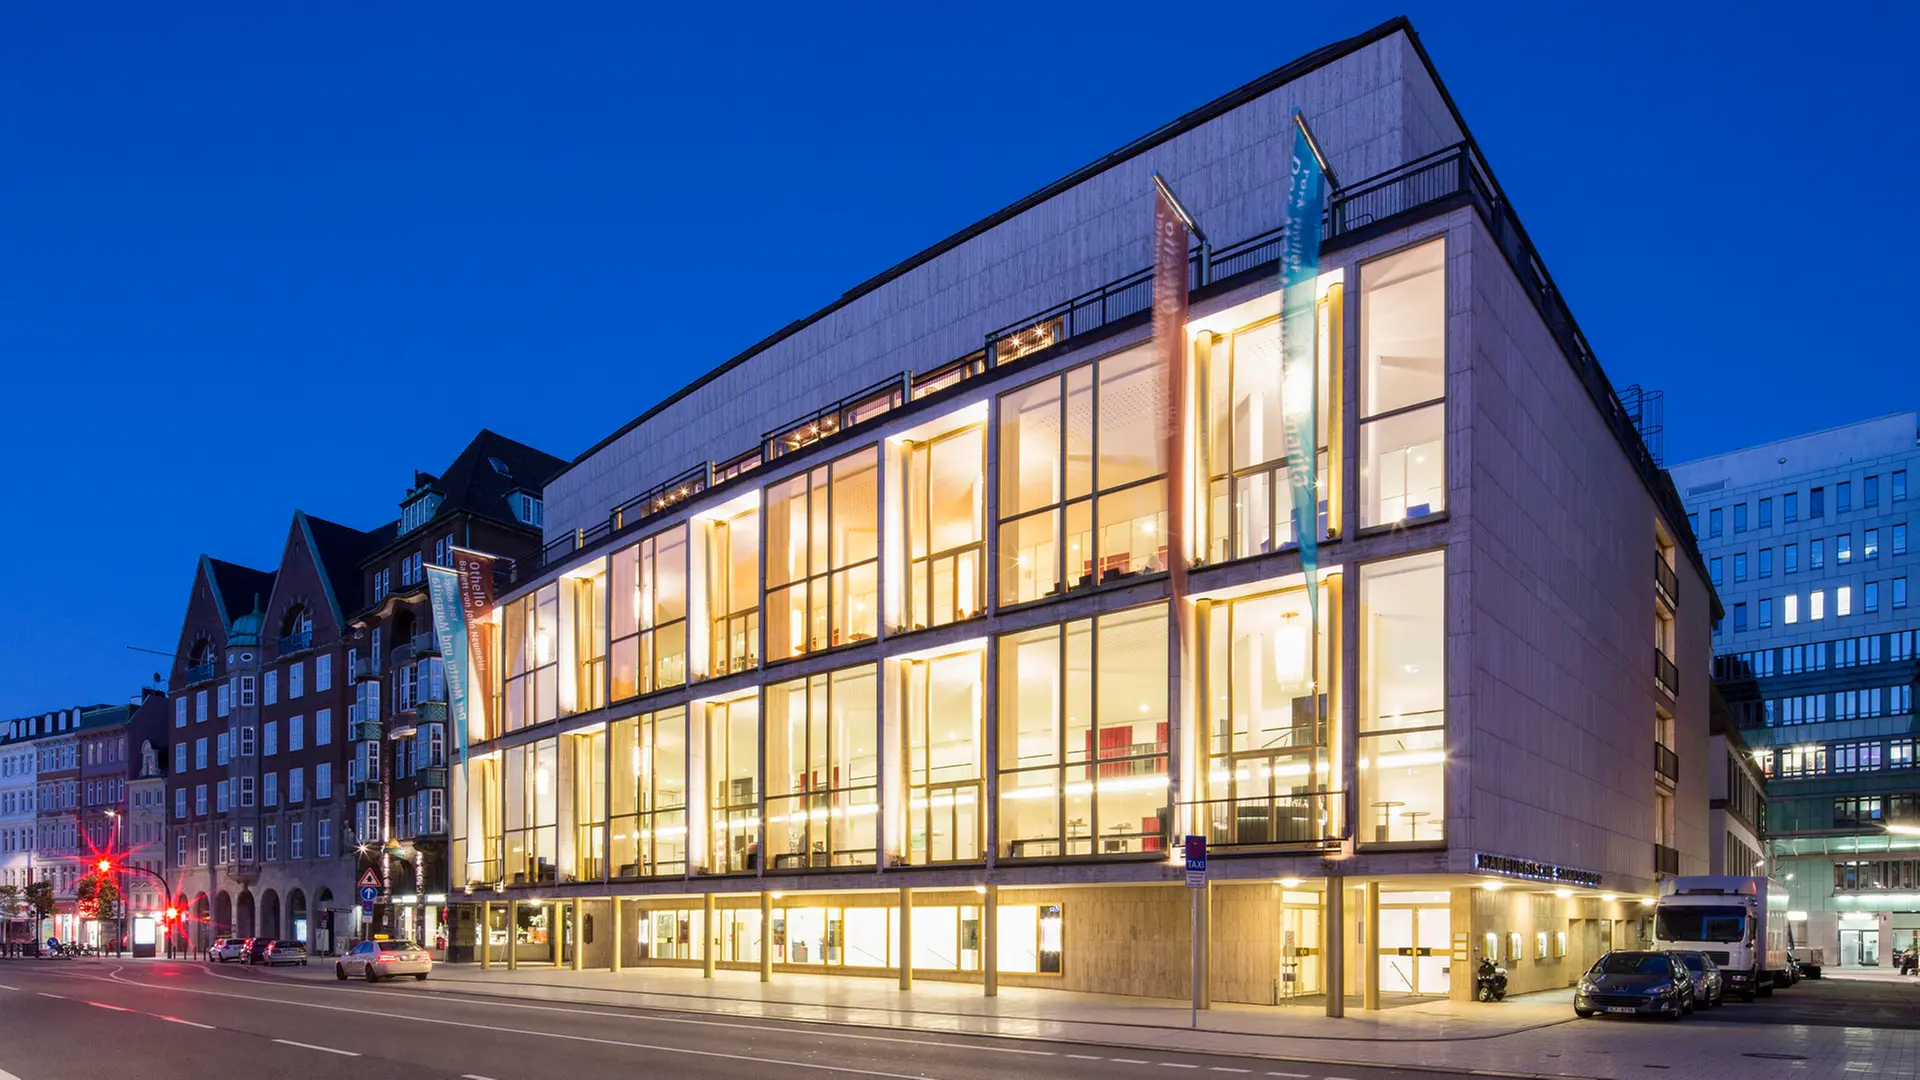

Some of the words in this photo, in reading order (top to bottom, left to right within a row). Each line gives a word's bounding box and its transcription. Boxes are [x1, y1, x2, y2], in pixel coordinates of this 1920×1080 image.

[463, 591, 472, 608] von
[469, 562, 484, 608] Othello
[464, 610, 476, 629] John
[470, 631, 486, 671] Neumeier
